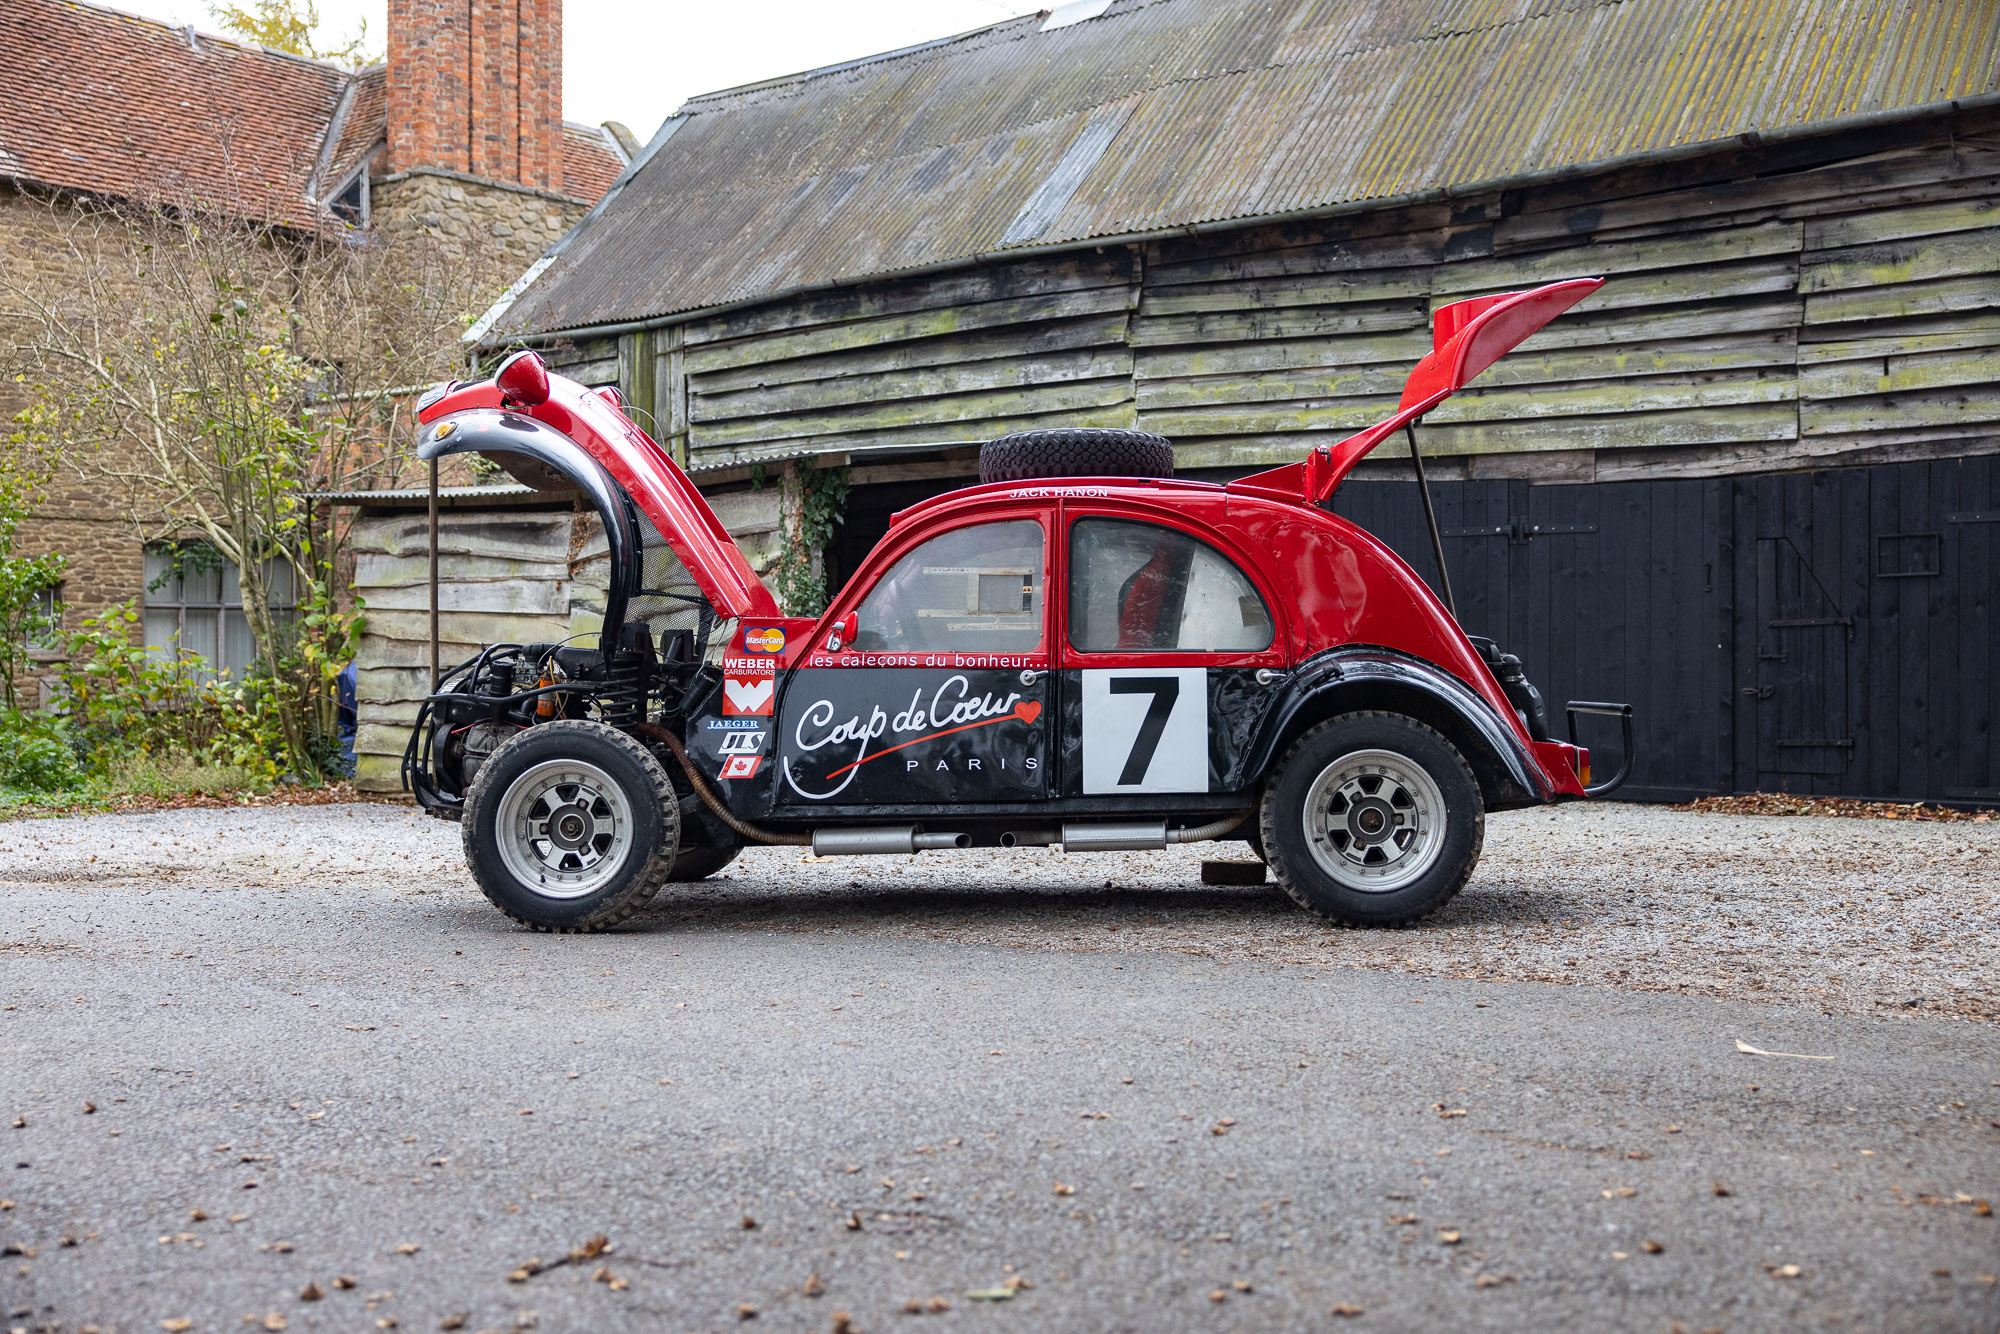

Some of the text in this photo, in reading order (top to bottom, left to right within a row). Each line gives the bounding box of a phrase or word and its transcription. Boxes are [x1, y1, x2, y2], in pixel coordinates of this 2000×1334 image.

[1009, 488, 1108, 498] JACK HANON
[745, 636, 785, 645] MasterCard
[724, 658, 776, 669] WEBER
[809, 654, 834, 667] les
[840, 653, 918, 668] caleçons
[925, 653, 947, 667] du
[723, 668, 776, 676] CARBURATORS
[706, 719, 760, 730] JAEGER
[1109, 676, 1180, 786] 7
[783, 699, 888, 799] Coup
[892, 688, 928, 732] de
[906, 757, 1039, 772] PARIS
